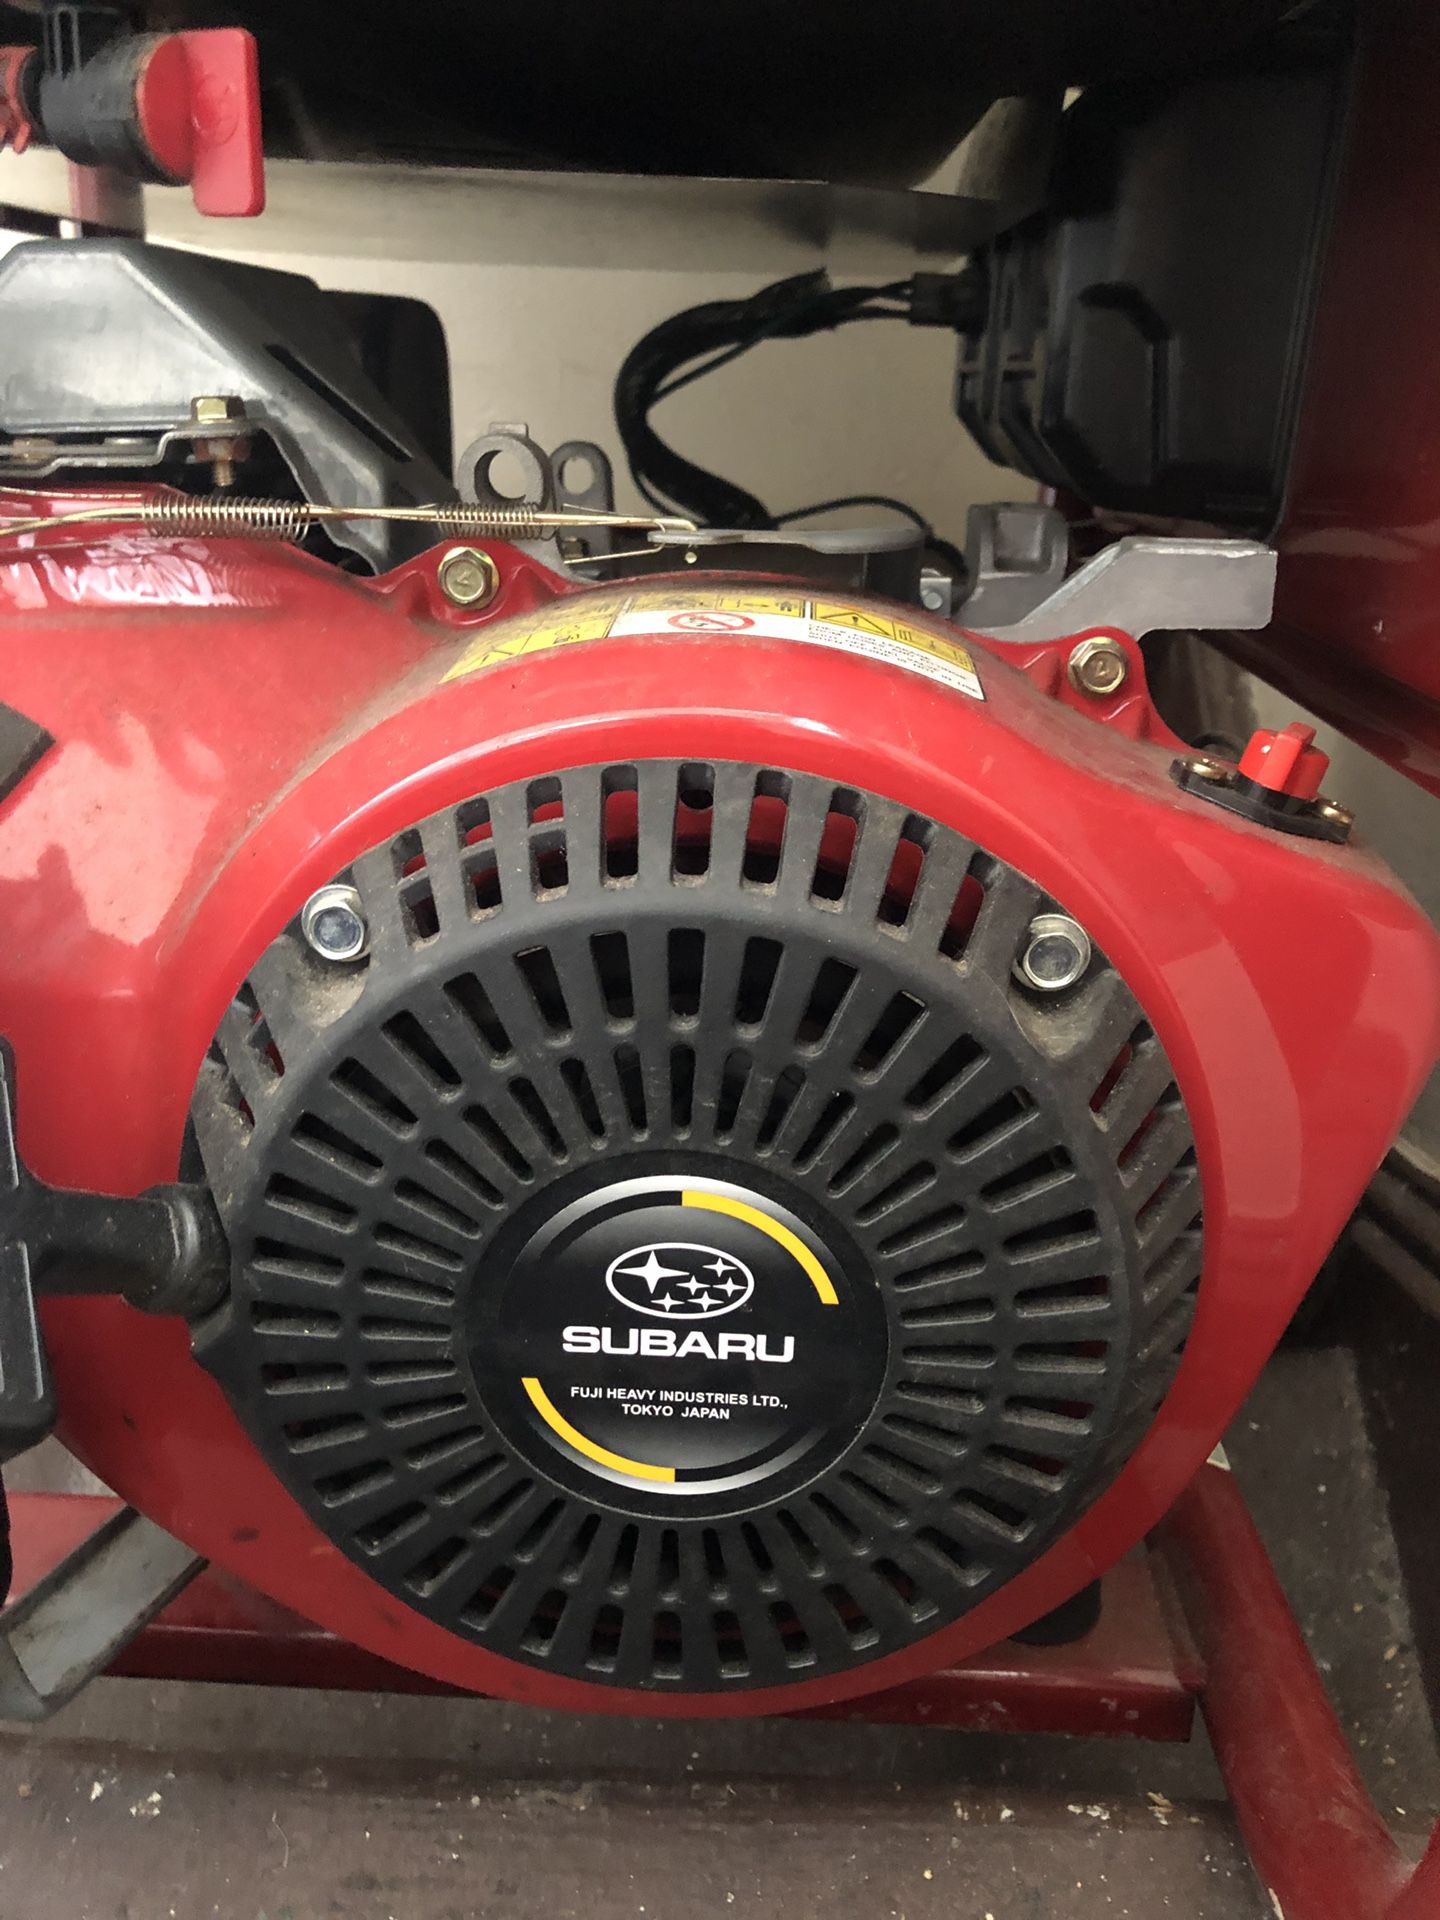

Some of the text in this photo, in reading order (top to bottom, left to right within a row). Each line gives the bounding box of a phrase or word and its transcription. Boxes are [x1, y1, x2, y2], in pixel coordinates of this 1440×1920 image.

[561, 1325, 796, 1363] SUBARU
[570, 1386, 789, 1410] FUJI HEAVY INDUSTRIES LTD.,
[621, 1403, 730, 1420] TOKYO JAPAN
